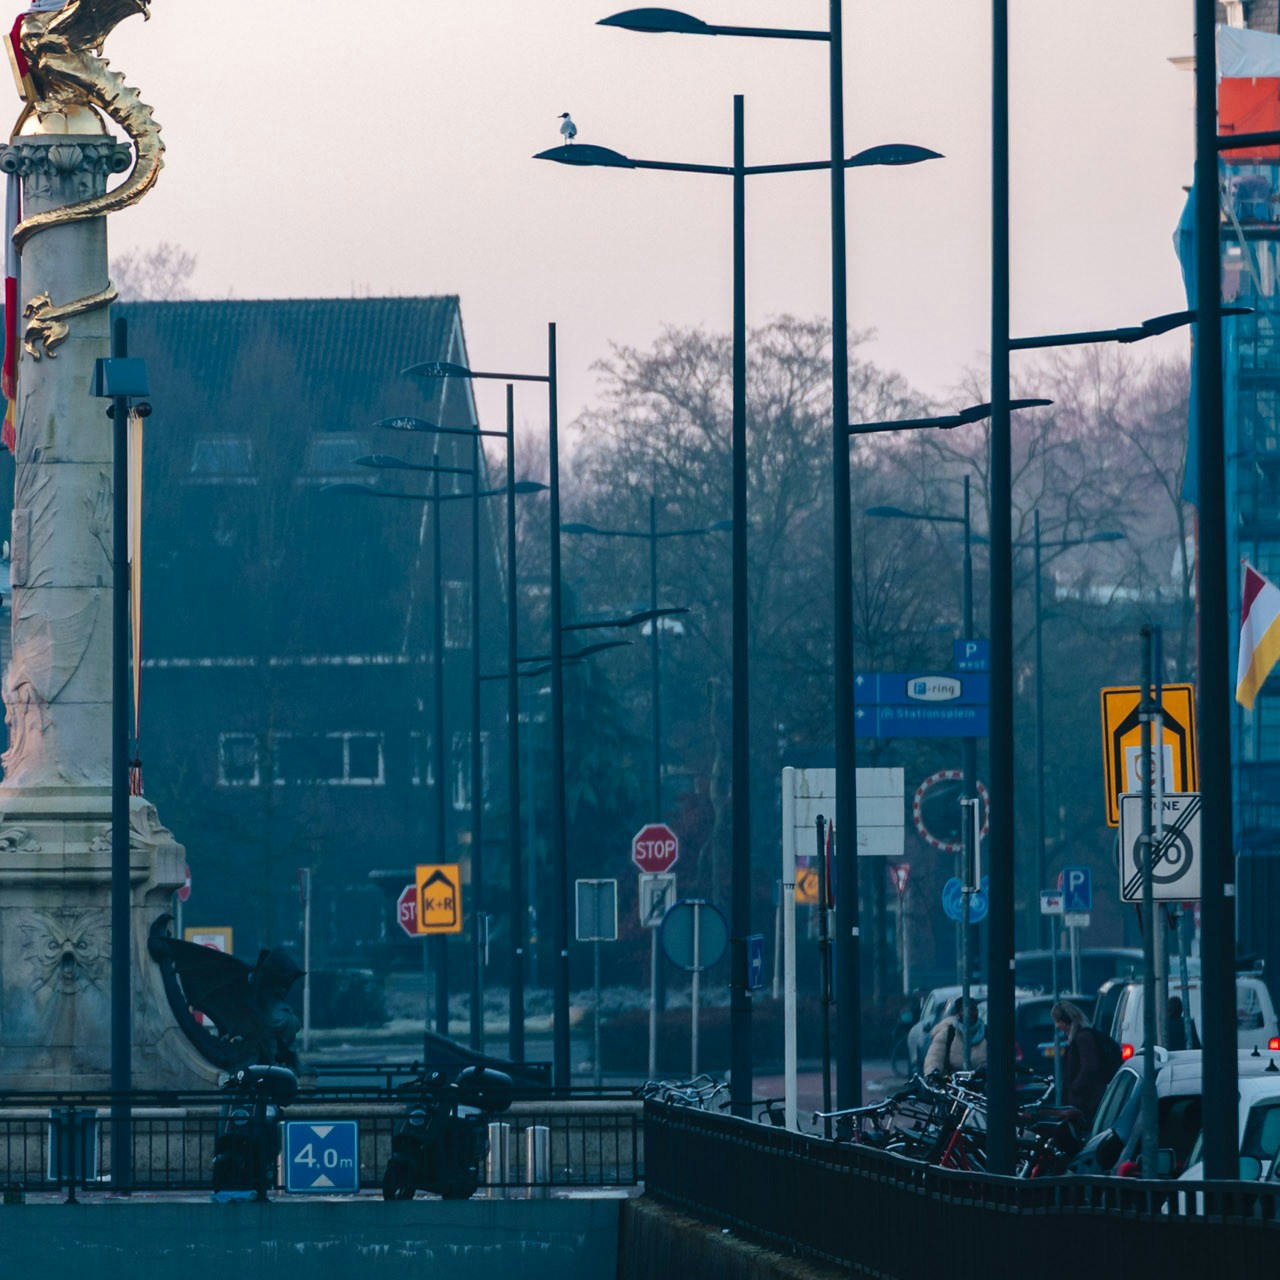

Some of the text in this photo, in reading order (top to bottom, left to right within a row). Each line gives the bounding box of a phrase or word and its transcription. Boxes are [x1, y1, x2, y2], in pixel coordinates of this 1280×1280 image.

[966, 643, 977, 658] P
[896, 707, 976, 719] Stationsplein
[636, 840, 675, 859] STOP
[1069, 870, 1085, 892] P
[401, 902, 417, 921] ST
[426, 897, 453, 911] K+R
